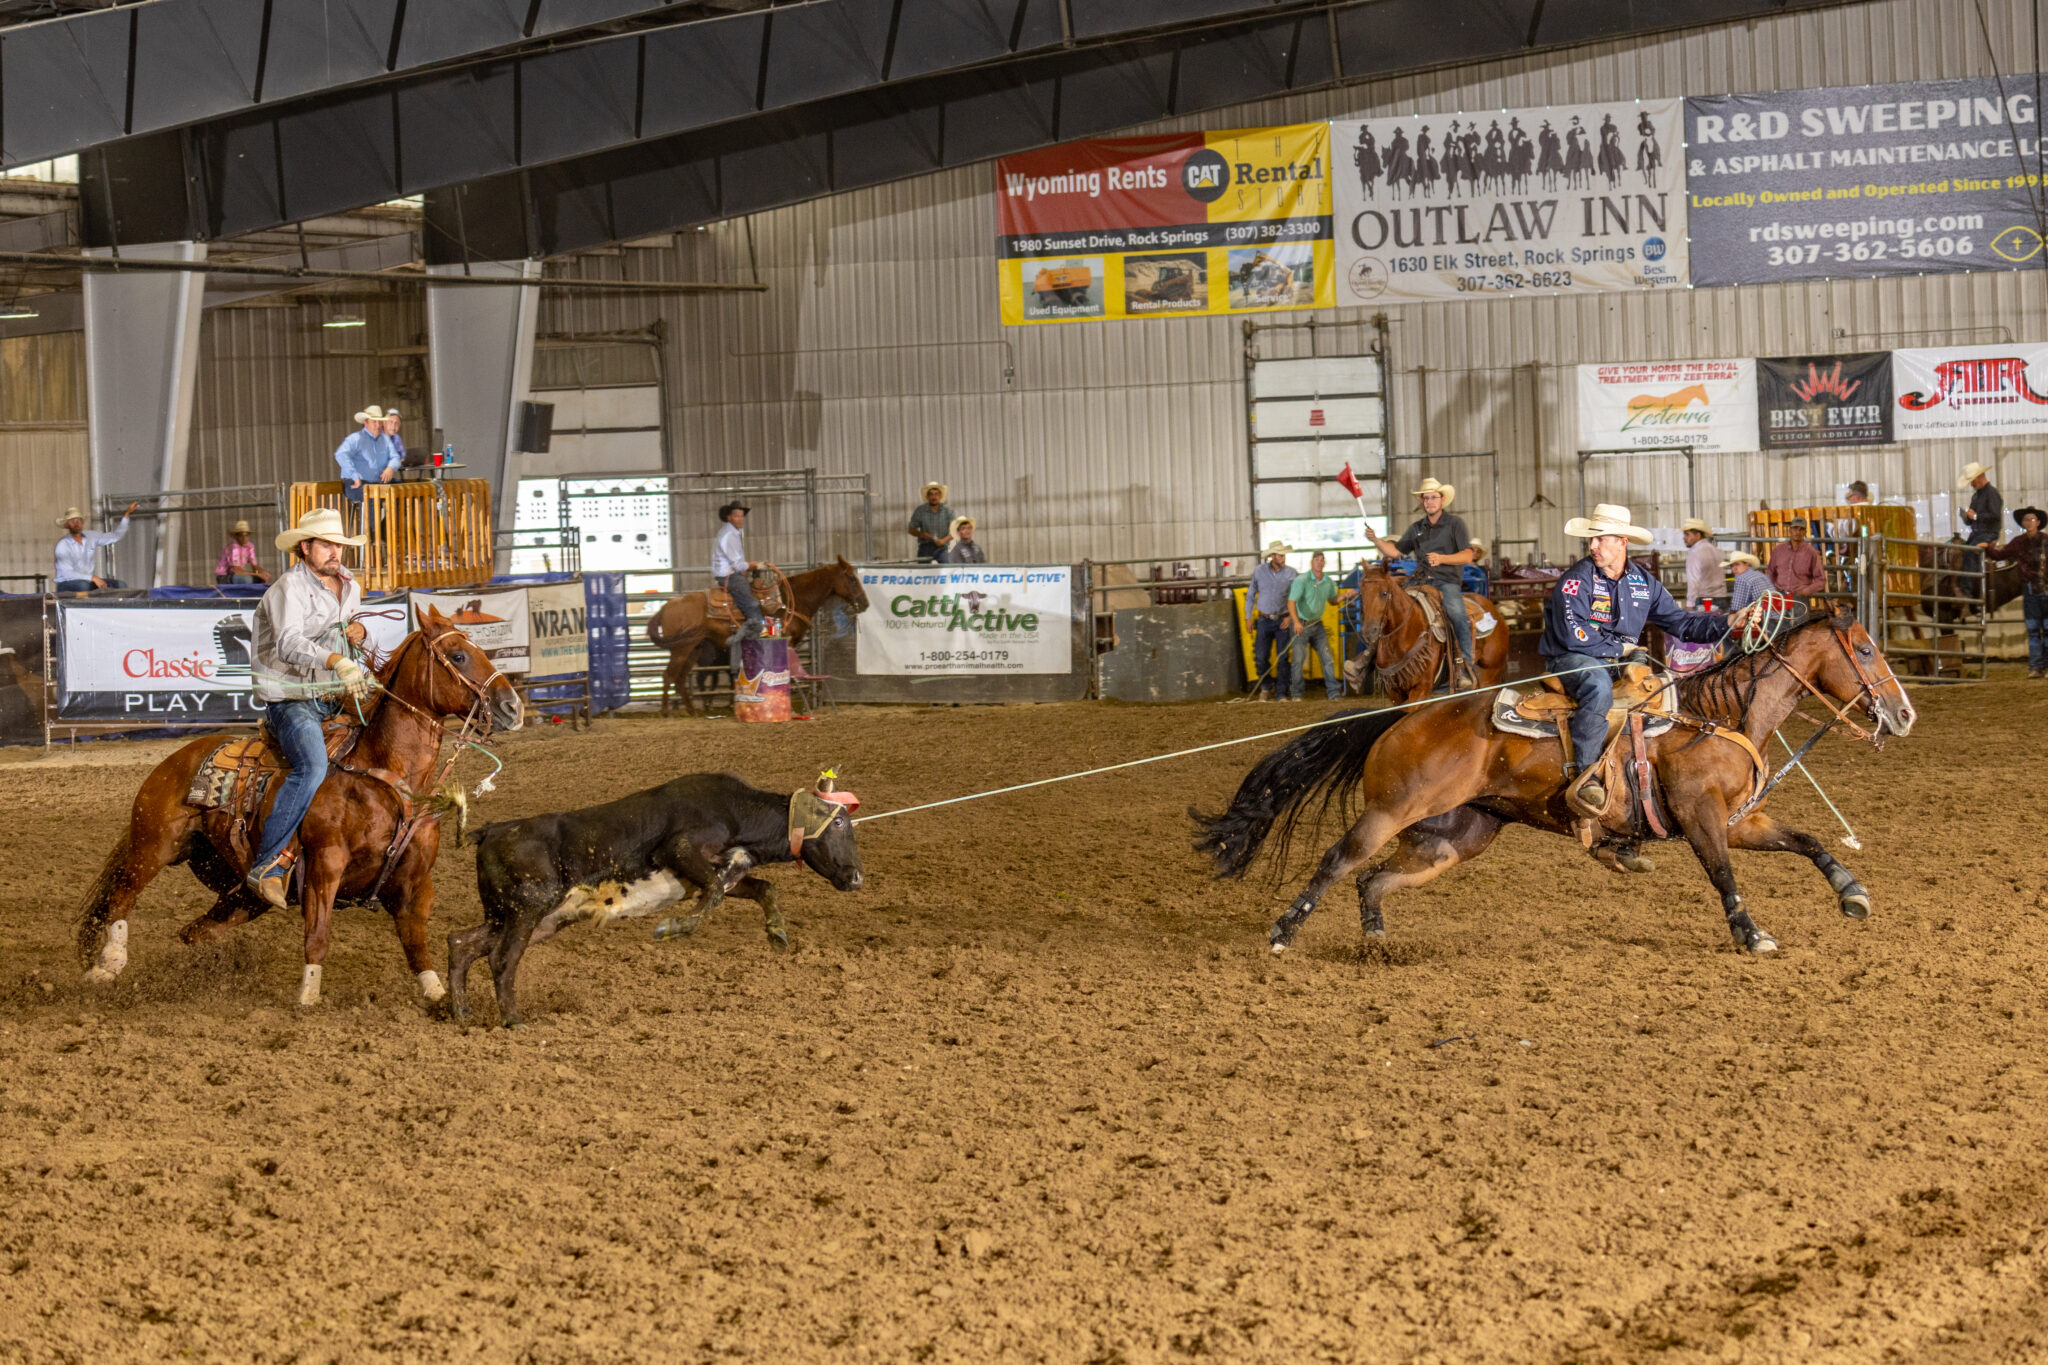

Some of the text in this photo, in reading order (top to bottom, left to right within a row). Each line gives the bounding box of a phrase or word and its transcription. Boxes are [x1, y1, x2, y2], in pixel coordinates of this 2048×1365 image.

[1696, 94, 2035, 144] R&D SWEEPING
[1689, 159, 1706, 177] &
[1712, 151, 1824, 176] ASPHALT
[1831, 139, 2014, 167] MAINTENANCE
[1188, 164, 1221, 188] CAT
[1234, 157, 1323, 185] Rental
[1005, 165, 1168, 202] Wyoming Rents
[1692, 190, 1756, 208] Locally
[1760, 188, 1819, 204] Owned
[1822, 185, 1860, 201] and
[1864, 180, 1949, 199] Operated
[1953, 177, 2001, 192] Since
[1238, 183, 1323, 210] STORE
[1225, 222, 1321, 241] (307) 382-3300
[1351, 193, 1669, 250] OUTLAW INN
[1751, 213, 1984, 242] rdsweeping.com
[1012, 230, 1209, 252] 1980 Sunset Drive, Rock Springs
[1767, 236, 1975, 266] 307-362-5606
[1389, 246, 1636, 273] 1630 Elk Street, Rock Springs
[1643, 264, 1667, 275] Best
[1457, 271, 1573, 293] 307-362-6623
[1634, 275, 1678, 286] Western
[1029, 303, 1100, 317] Used Equipment
[1132, 297, 1201, 311] Rental Products
[1597, 361, 1739, 376] GIVE YOUR HORSE THE ROYAL
[1598, 374, 1655, 385] TREATMENT
[1657, 373, 1682, 383] WITH
[1620, 404, 1713, 432] Zesterra
[1770, 405, 1882, 428] BEST EVER
[1902, 422, 1923, 430] Your
[1981, 418, 1998, 427] and
[1632, 434, 1708, 446] 1-800-254-0179
[1770, 428, 1883, 441] CUSTOM SADDLE PADS
[863, 575, 878, 584] BE
[880, 574, 947, 585] PROACTIVE
[950, 574, 979, 583] WITH
[885, 619, 947, 630] 100% Natural
[946, 608, 1040, 632] Active
[122, 648, 214, 679] Classic
[904, 661, 1024, 670] www.proearthanimalhealth.com
[920, 650, 1009, 662] 1-800-254-0179
[125, 693, 211, 712] PLAY
